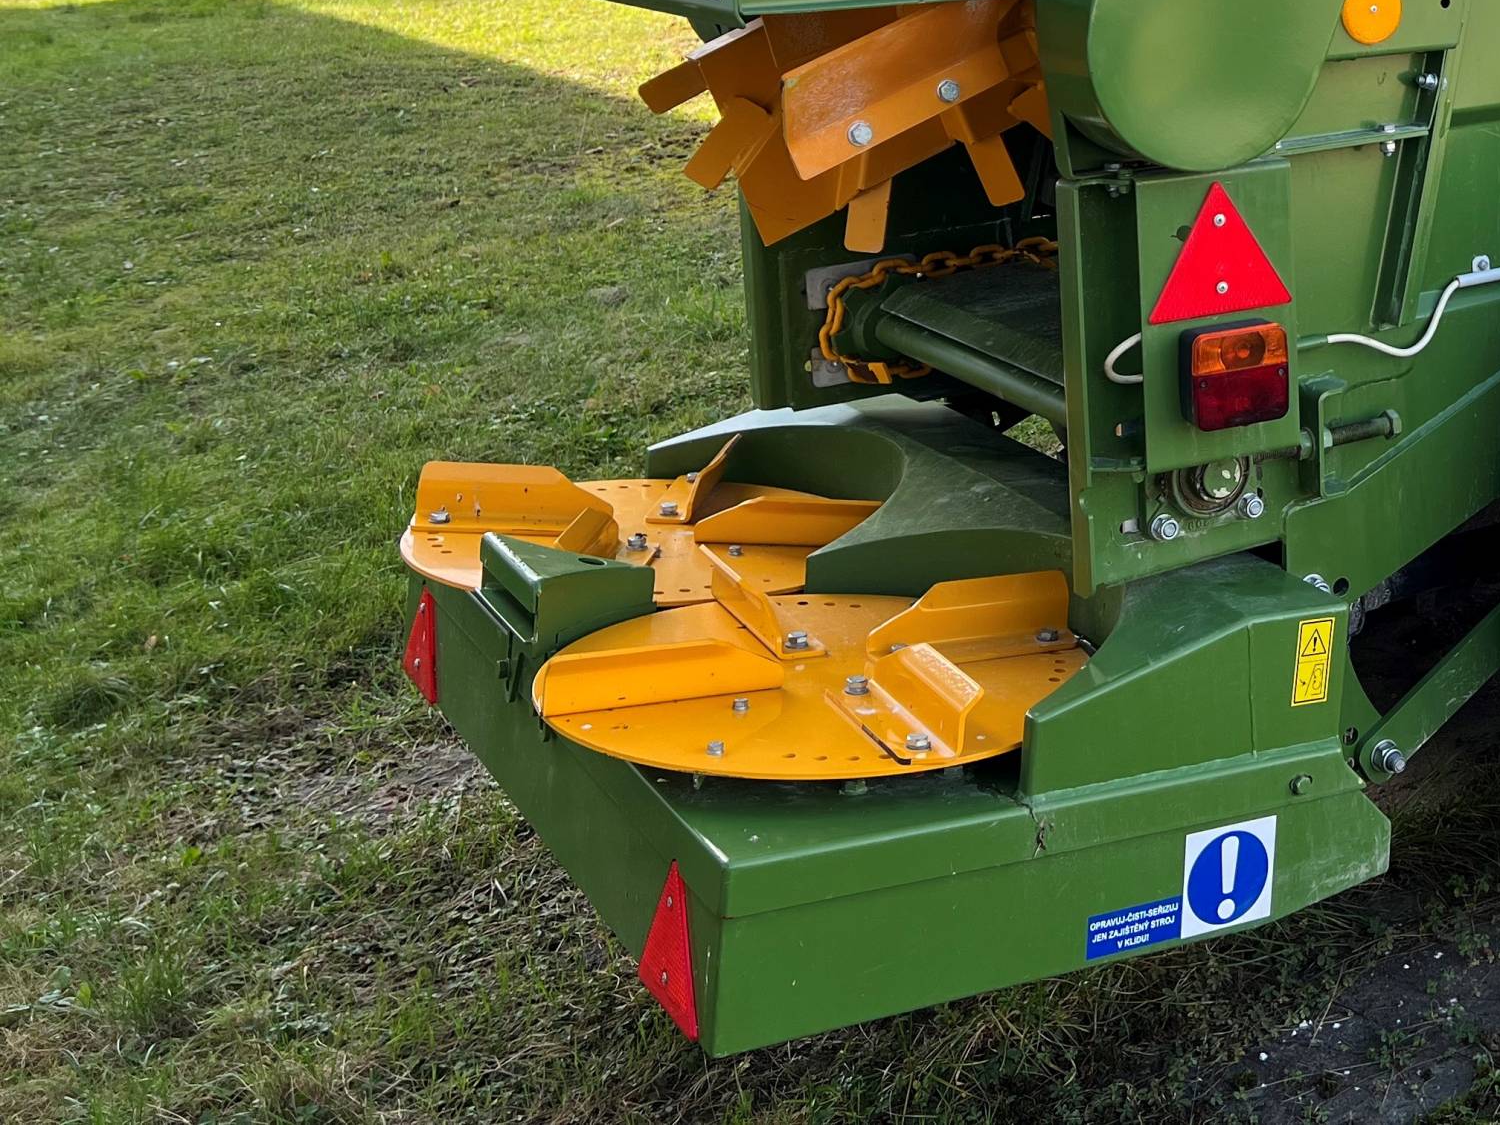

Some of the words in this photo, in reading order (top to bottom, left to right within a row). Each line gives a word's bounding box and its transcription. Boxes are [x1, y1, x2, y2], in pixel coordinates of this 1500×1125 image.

[1091, 931, 1108, 943] JEN
[1108, 920, 1150, 939] ZAJIŠTĚNÝ
[1150, 915, 1176, 929] STROJ
[1117, 940, 1124, 949] V
[1124, 934, 1150, 947] KLIDU!
